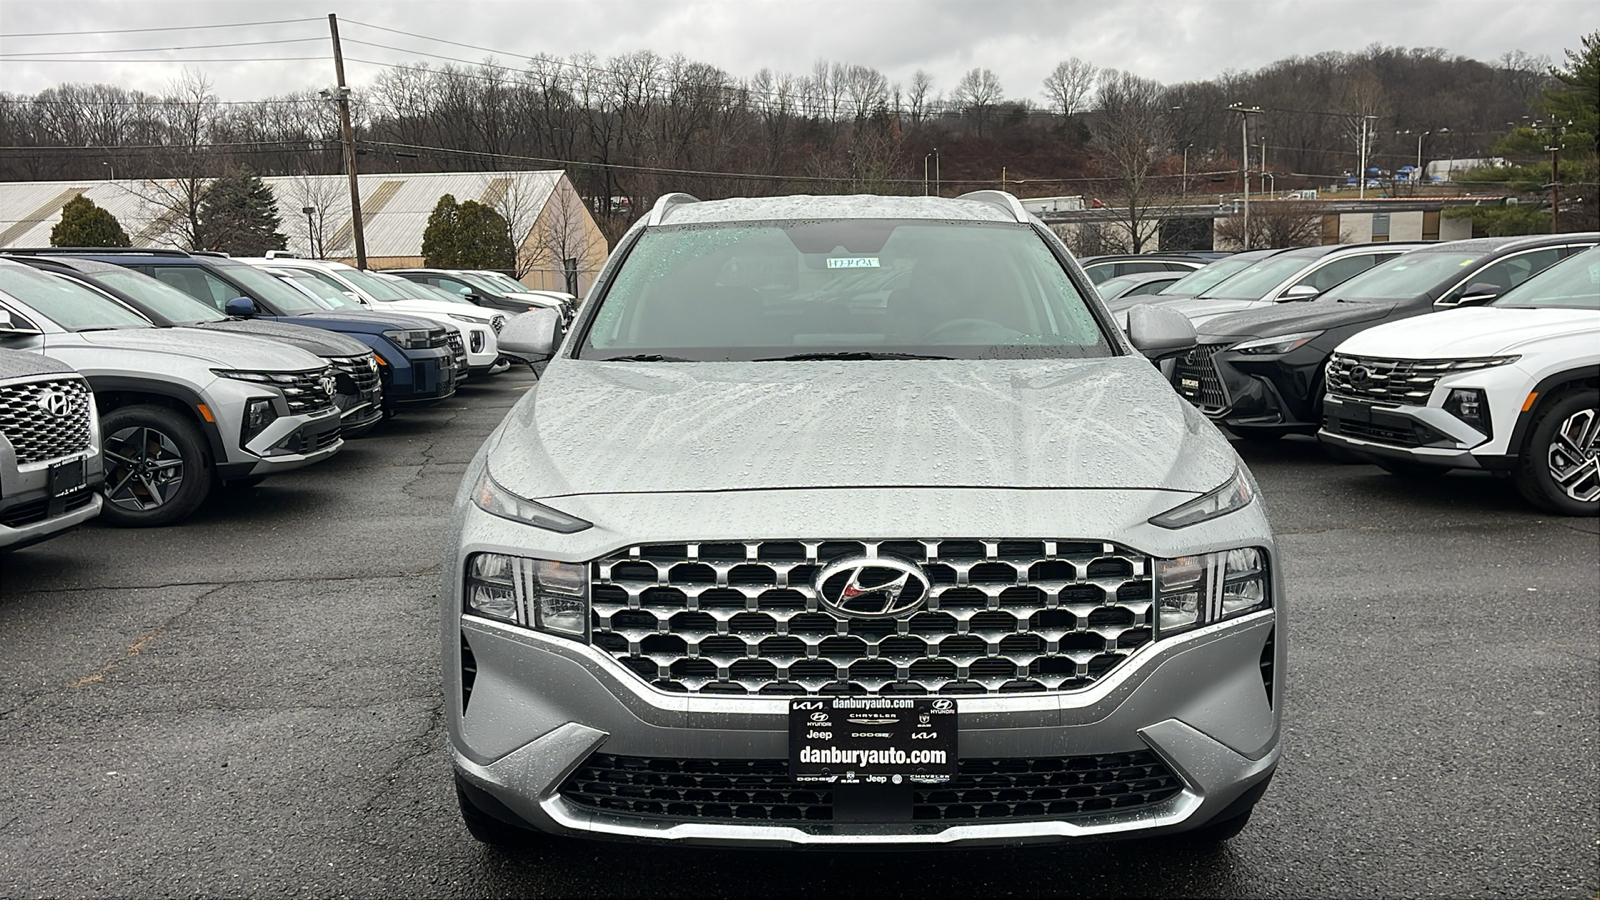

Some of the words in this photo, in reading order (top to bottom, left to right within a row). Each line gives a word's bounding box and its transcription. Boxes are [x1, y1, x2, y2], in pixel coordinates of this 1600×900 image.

[832, 697, 914, 710] danburyauto.com
[806, 729, 833, 741] Jeep
[800, 745, 946, 768] danburyauto.com
[865, 774, 887, 784] Jeep
